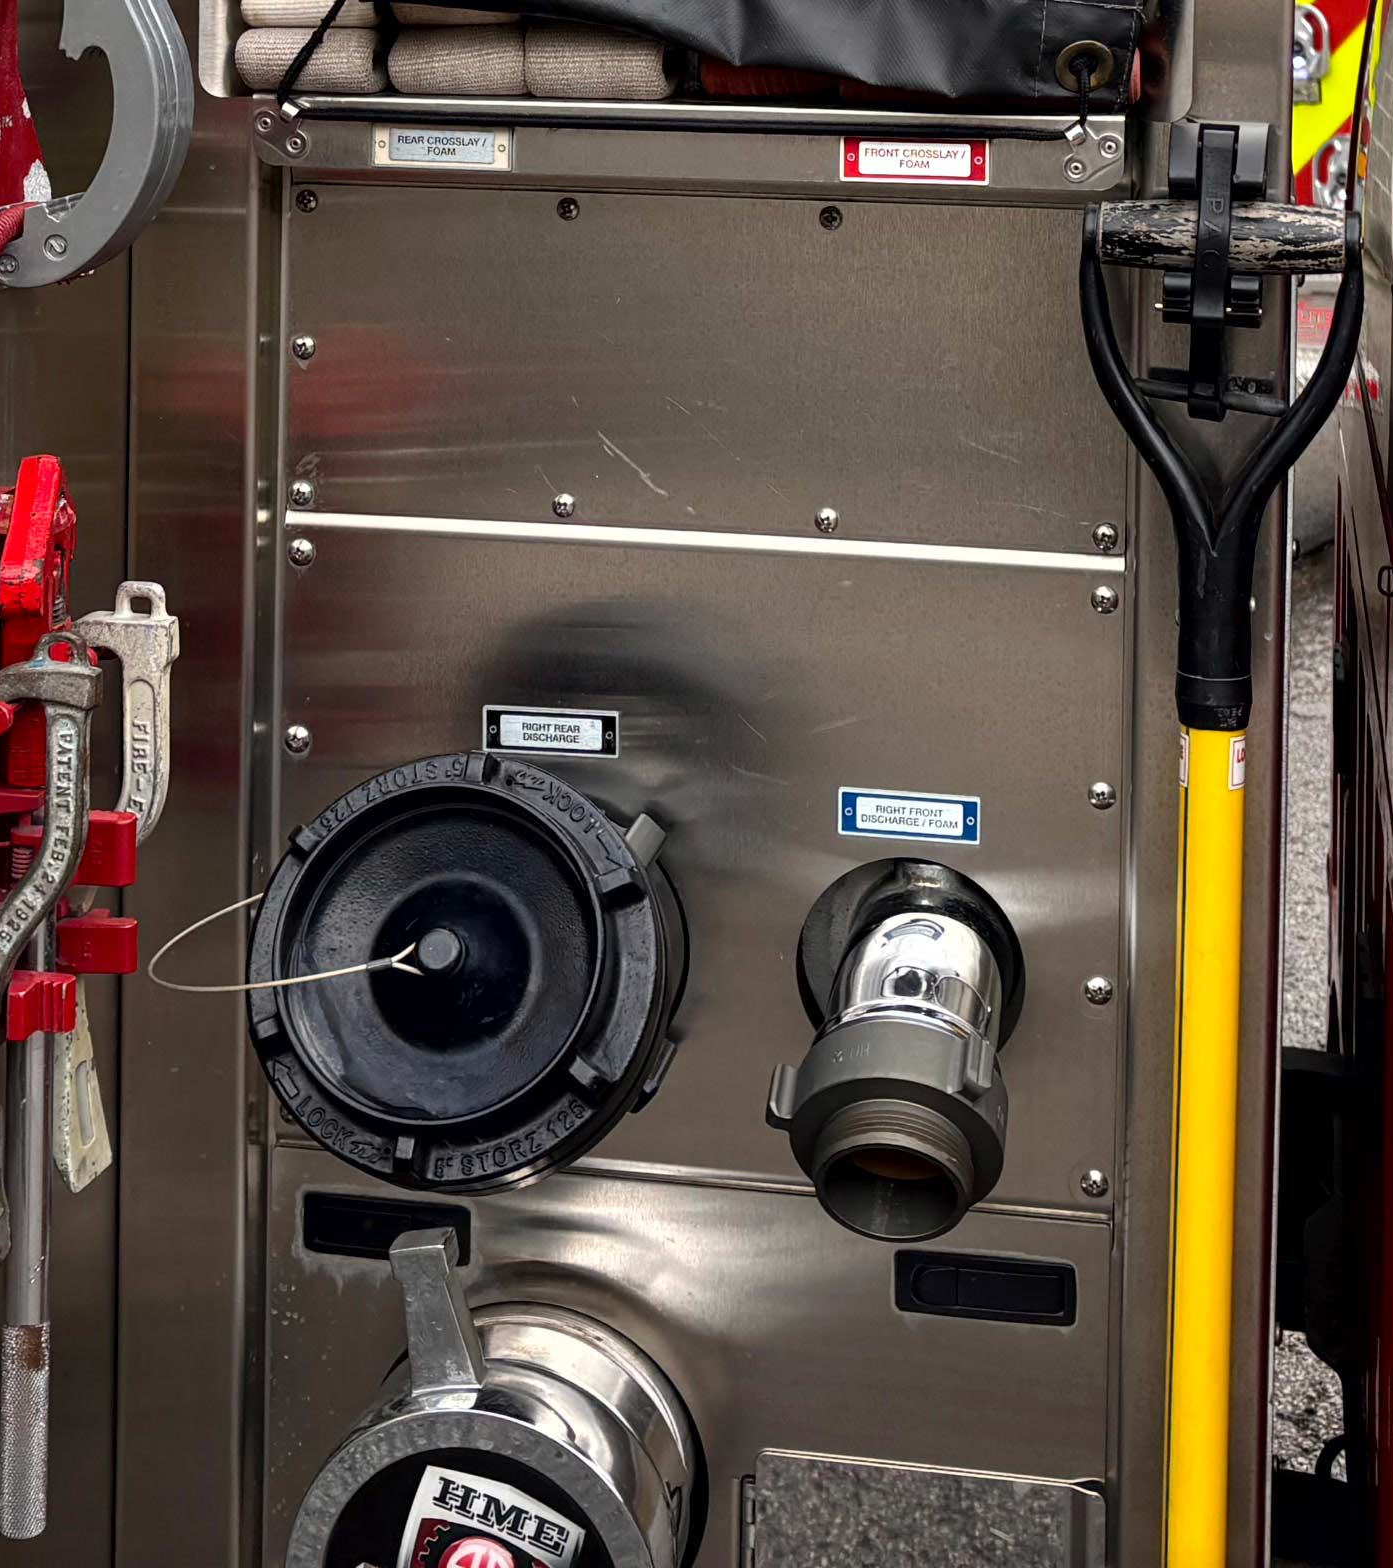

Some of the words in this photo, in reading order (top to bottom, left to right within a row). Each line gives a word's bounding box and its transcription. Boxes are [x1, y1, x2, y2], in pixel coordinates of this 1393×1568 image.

[397, 135, 425, 145] REAR
[426, 136, 481, 147] CROSSLAY
[427, 146, 457, 156] FOAM
[864, 148, 899, 158] FRONT
[902, 149, 959, 159] CROSSLAY
[899, 159, 930, 169] FOAM
[521, 722, 552, 733] RIGHT
[554, 724, 581, 734] REAR
[522, 733, 581, 744] DISCHARGE
[56, 732, 75, 814] PATENT
[361, 760, 439, 803] STORZ
[541, 780, 602, 835] LOCK
[875, 805, 907, 815] RIGHT
[909, 807, 944, 818] FRONT
[860, 814, 920, 827] DISCHARGE
[928, 819, 959, 829] FOAM
[295, 1094, 354, 1149] LOCK
[460, 1131, 545, 1177] STORZ
[547, 1098, 589, 1147] 125
[432, 1475, 570, 1558] HME
